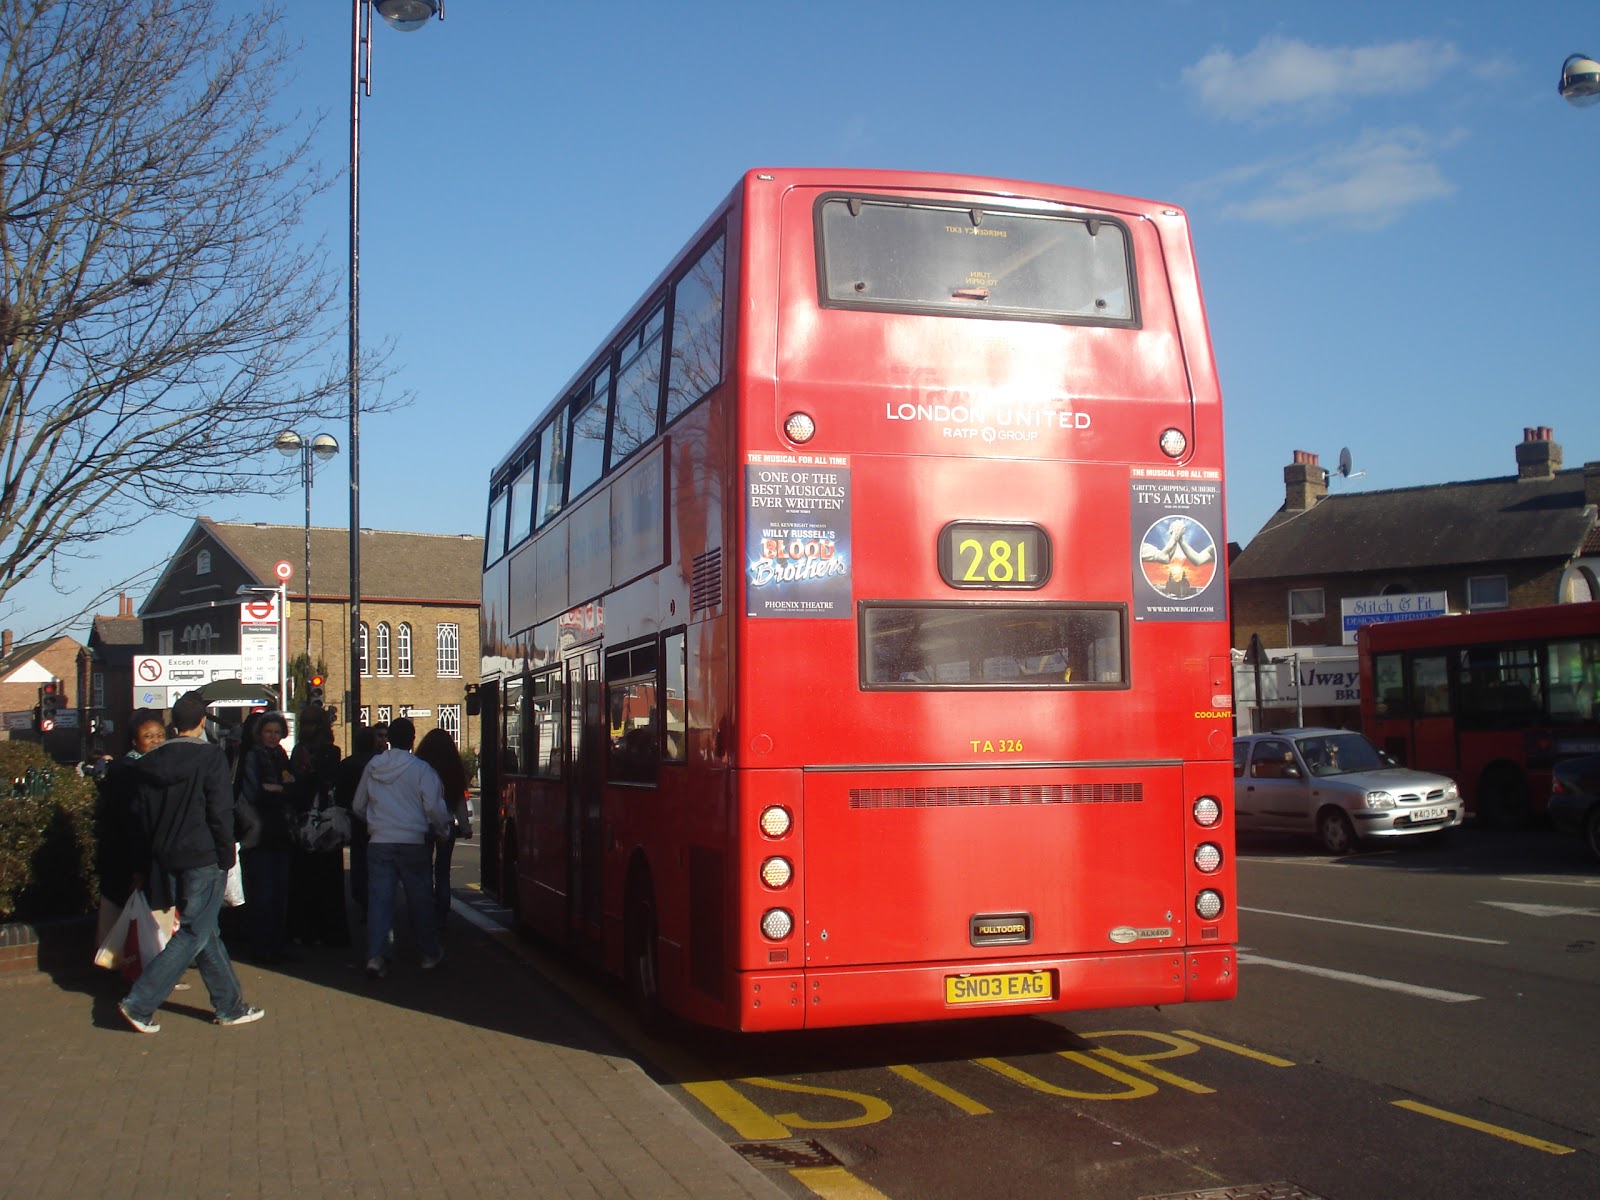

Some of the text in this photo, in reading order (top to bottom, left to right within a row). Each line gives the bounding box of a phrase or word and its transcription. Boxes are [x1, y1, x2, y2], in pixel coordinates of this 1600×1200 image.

[886, 403, 1091, 429] LONDON UNITED
[943, 428, 1038, 441] RATP GROUP
[748, 454, 847, 465] THE MUSICAL FOR ALL TIME
[791, 473, 809, 483] OF
[812, 473, 837, 484] THE
[1146, 469, 1175, 477] MUSICAL
[1190, 470, 1202, 478] ALL
[751, 484, 845, 497] BEST MUSICALS
[751, 497, 783, 508] EVER
[1138, 493, 1161, 503] IT'S
[1163, 494, 1172, 503] A
[763, 529, 835, 539] WILLY RUSSELL'S
[762, 539, 835, 560] BLOOD
[960, 539, 1025, 582] 281
[751, 556, 846, 586] Brothers
[1354, 596, 1433, 614] Stitch & Fit
[970, 739, 1023, 752] TA 326
[1008, 976, 1043, 994] EAG
